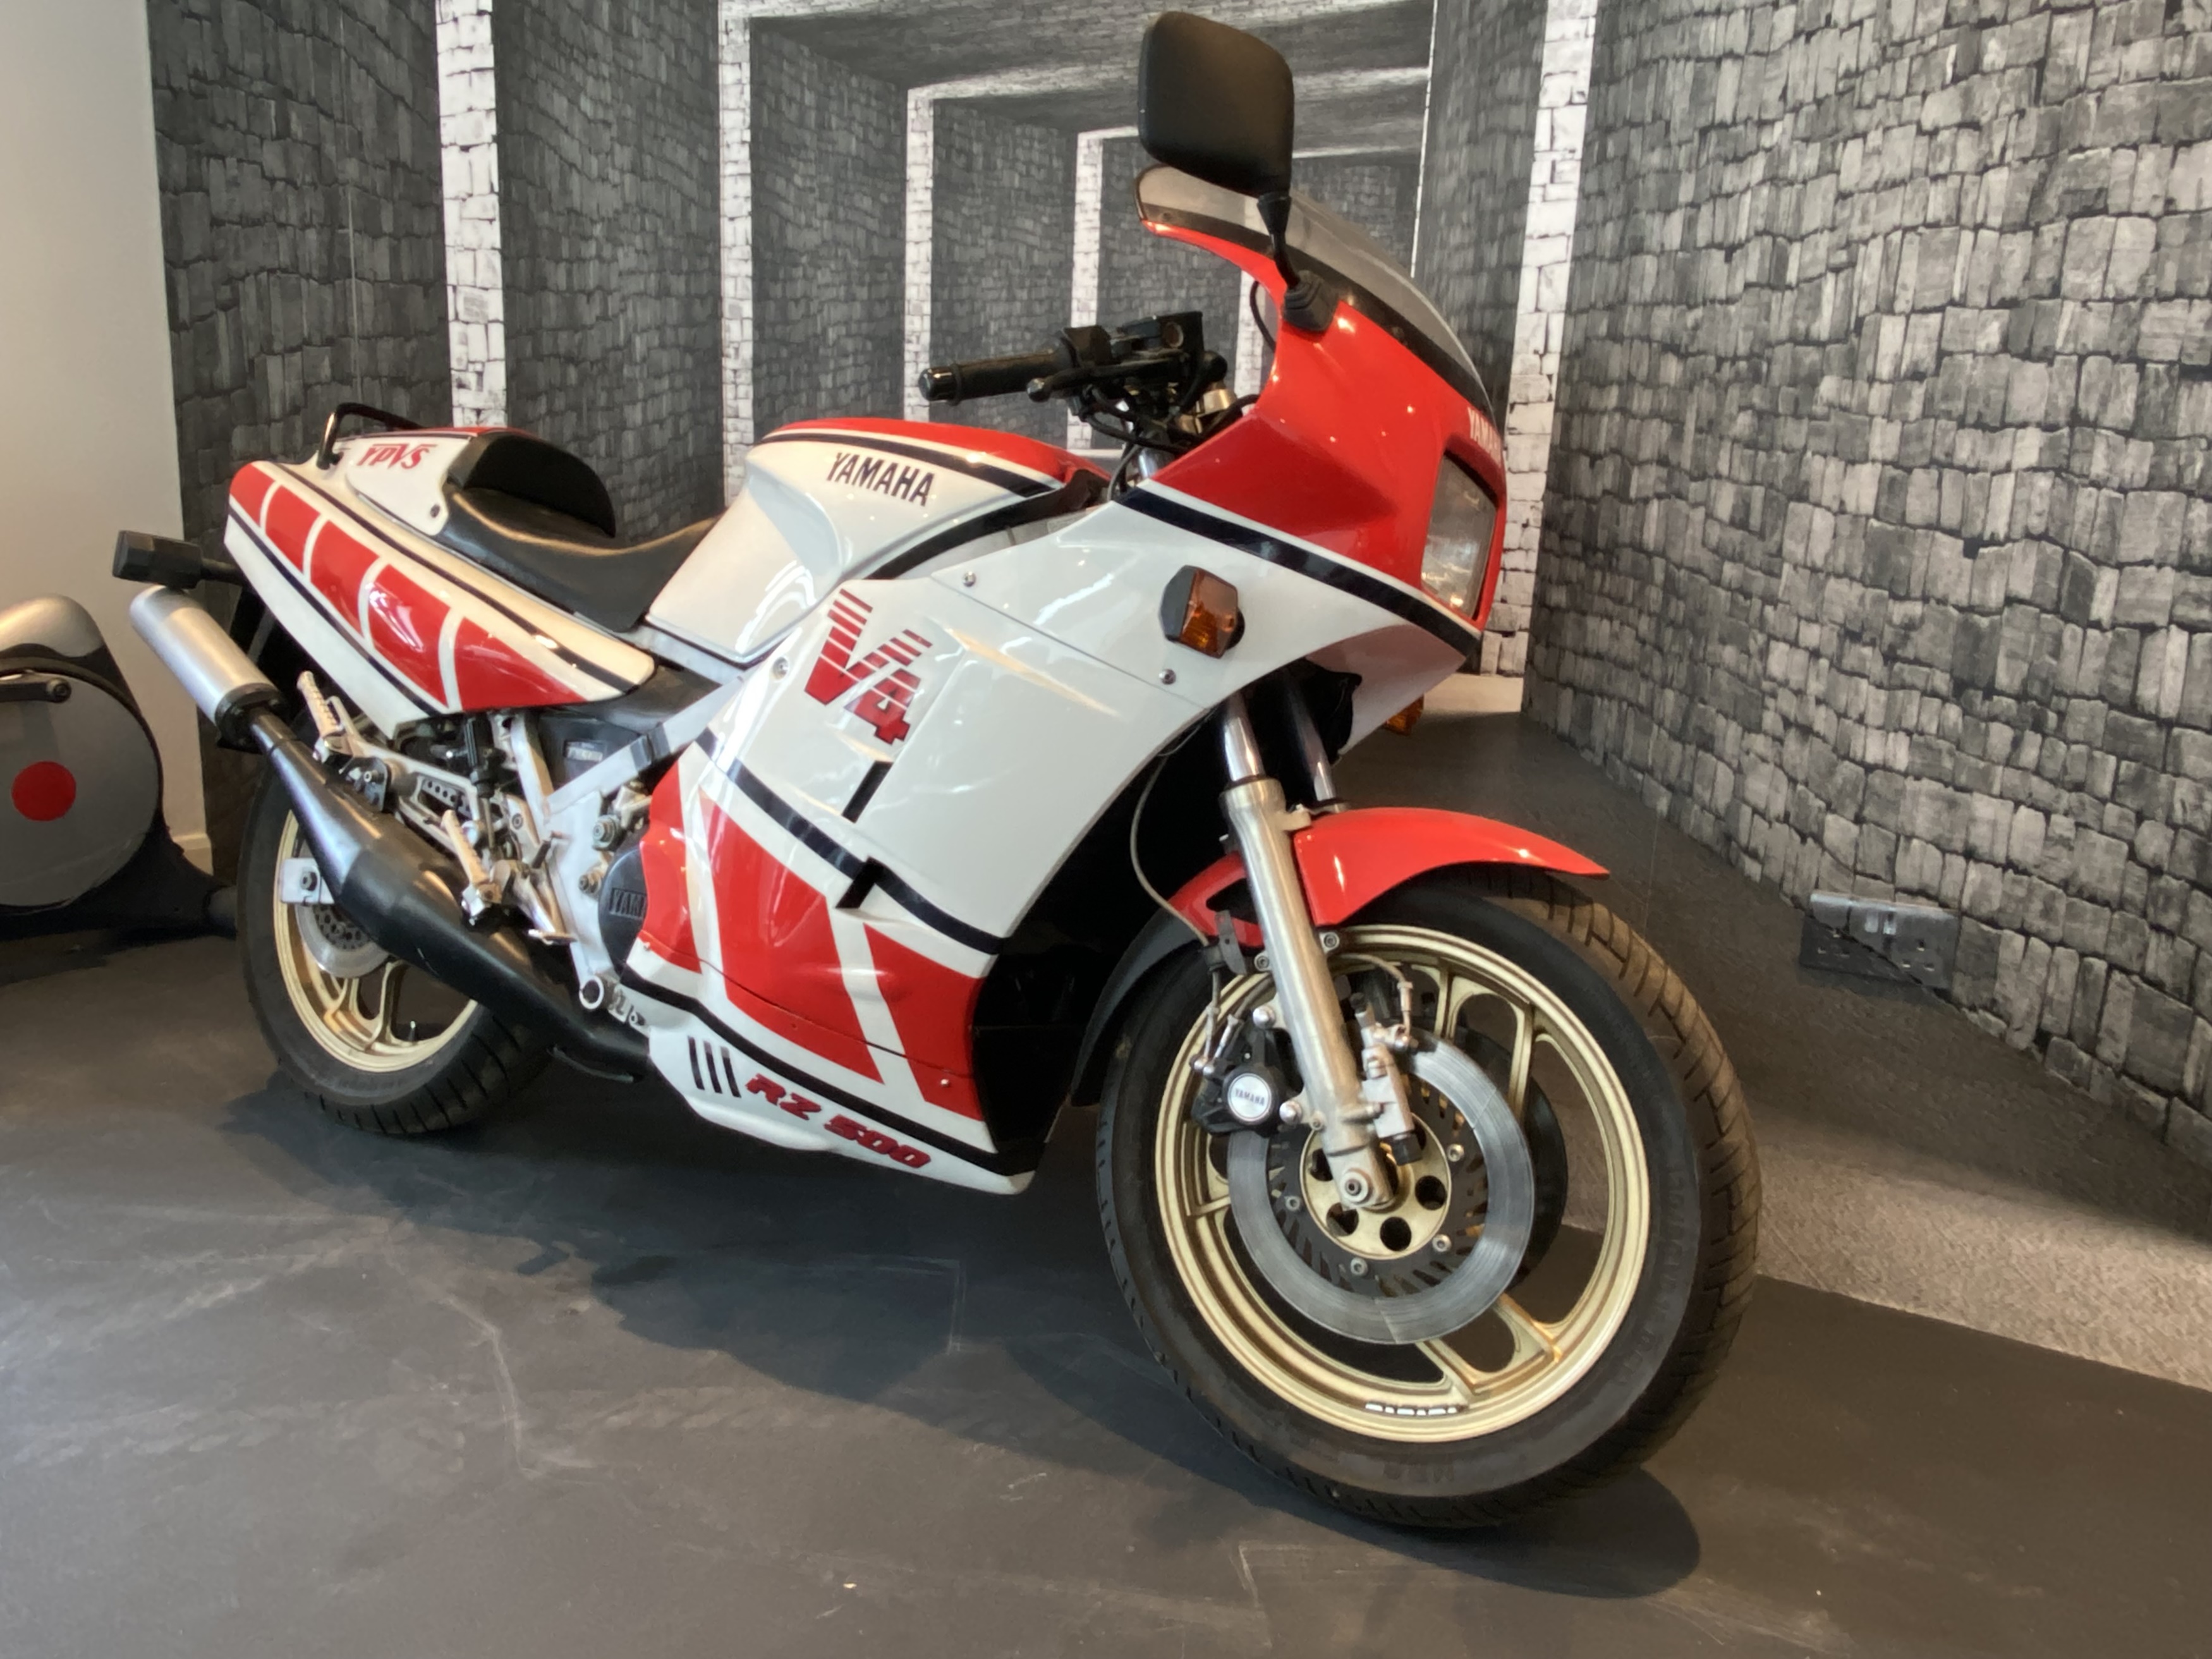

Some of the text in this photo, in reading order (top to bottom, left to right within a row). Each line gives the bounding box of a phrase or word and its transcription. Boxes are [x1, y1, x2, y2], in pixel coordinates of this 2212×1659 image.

[356, 443, 437, 469] YPVS
[827, 452, 935, 507] YAMAHA
[804, 588, 933, 745] V4
[745, 1073, 932, 1169] RZ 500
[1234, 1088, 1265, 1107] YAMAHA
